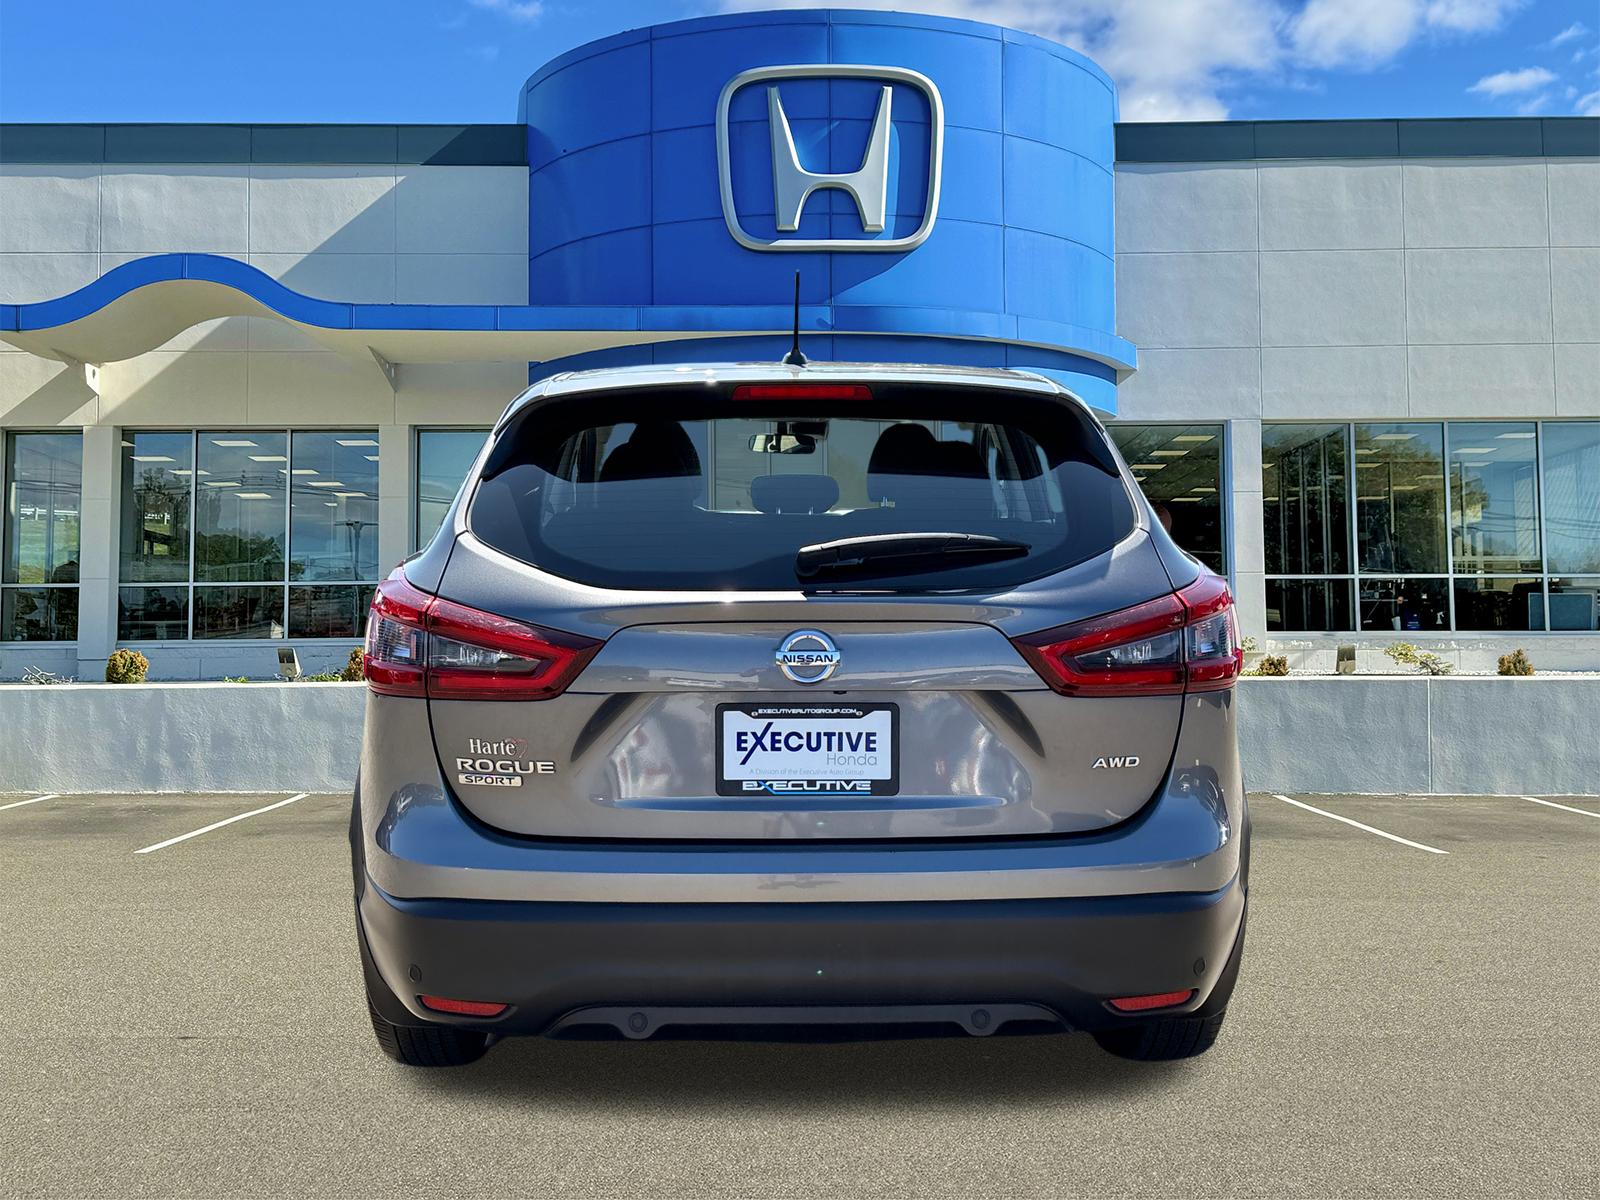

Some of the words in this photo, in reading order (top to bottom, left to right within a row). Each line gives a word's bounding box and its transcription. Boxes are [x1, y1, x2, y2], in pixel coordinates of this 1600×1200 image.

[782, 654, 834, 663] NISSAN
[469, 738, 516, 756] Harte
[736, 722, 877, 766] EXECUTIVE
[826, 753, 878, 766] Honda
[1092, 756, 1140, 768] AWD
[456, 758, 555, 774] ROGUE
[845, 768, 865, 777] Group
[464, 775, 515, 785] SPORT
[742, 780, 871, 791] EXECUTIVE
